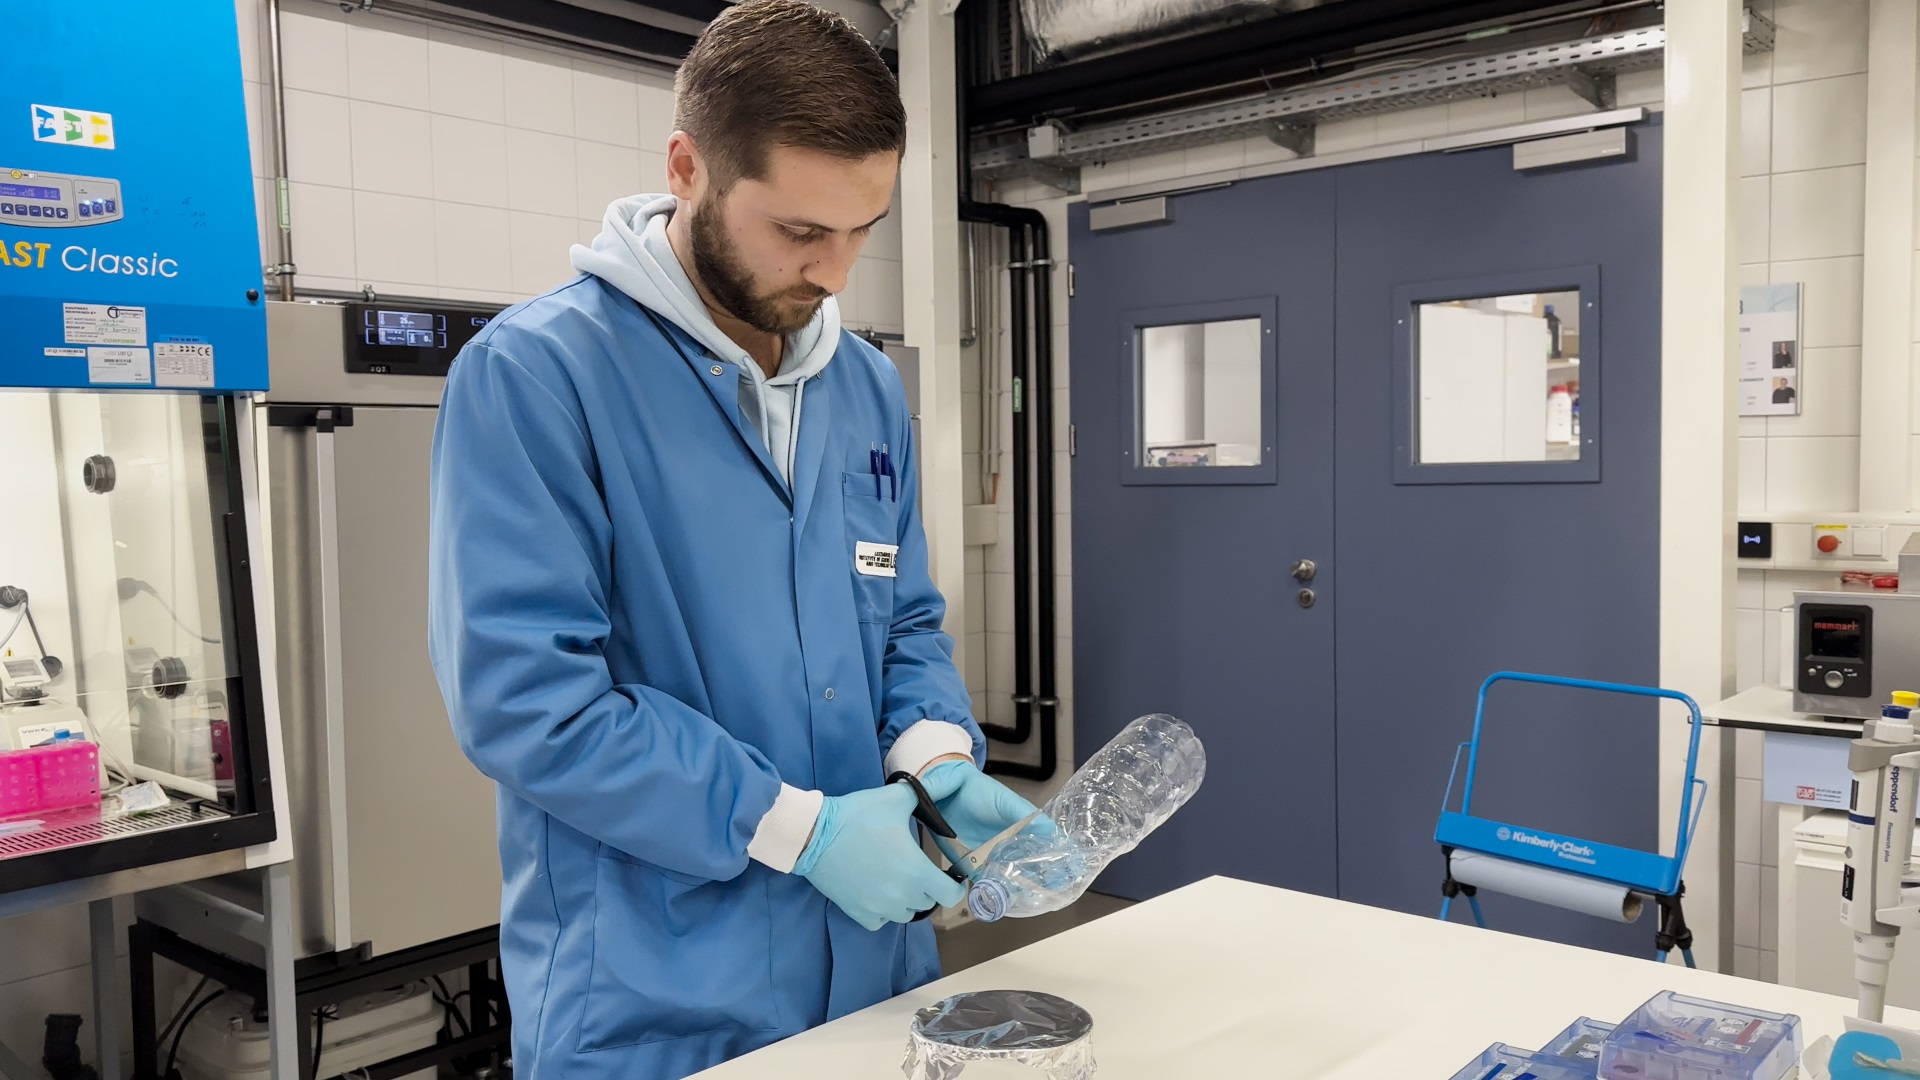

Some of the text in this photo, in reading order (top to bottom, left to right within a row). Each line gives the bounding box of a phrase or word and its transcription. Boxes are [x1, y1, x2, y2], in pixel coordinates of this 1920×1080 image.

[61, 245, 178, 278] Classic
[1889, 766, 1900, 813] eppendorf
[1512, 831, 1591, 857] Kimberly-Clark
[1885, 821, 1894, 849] Research
